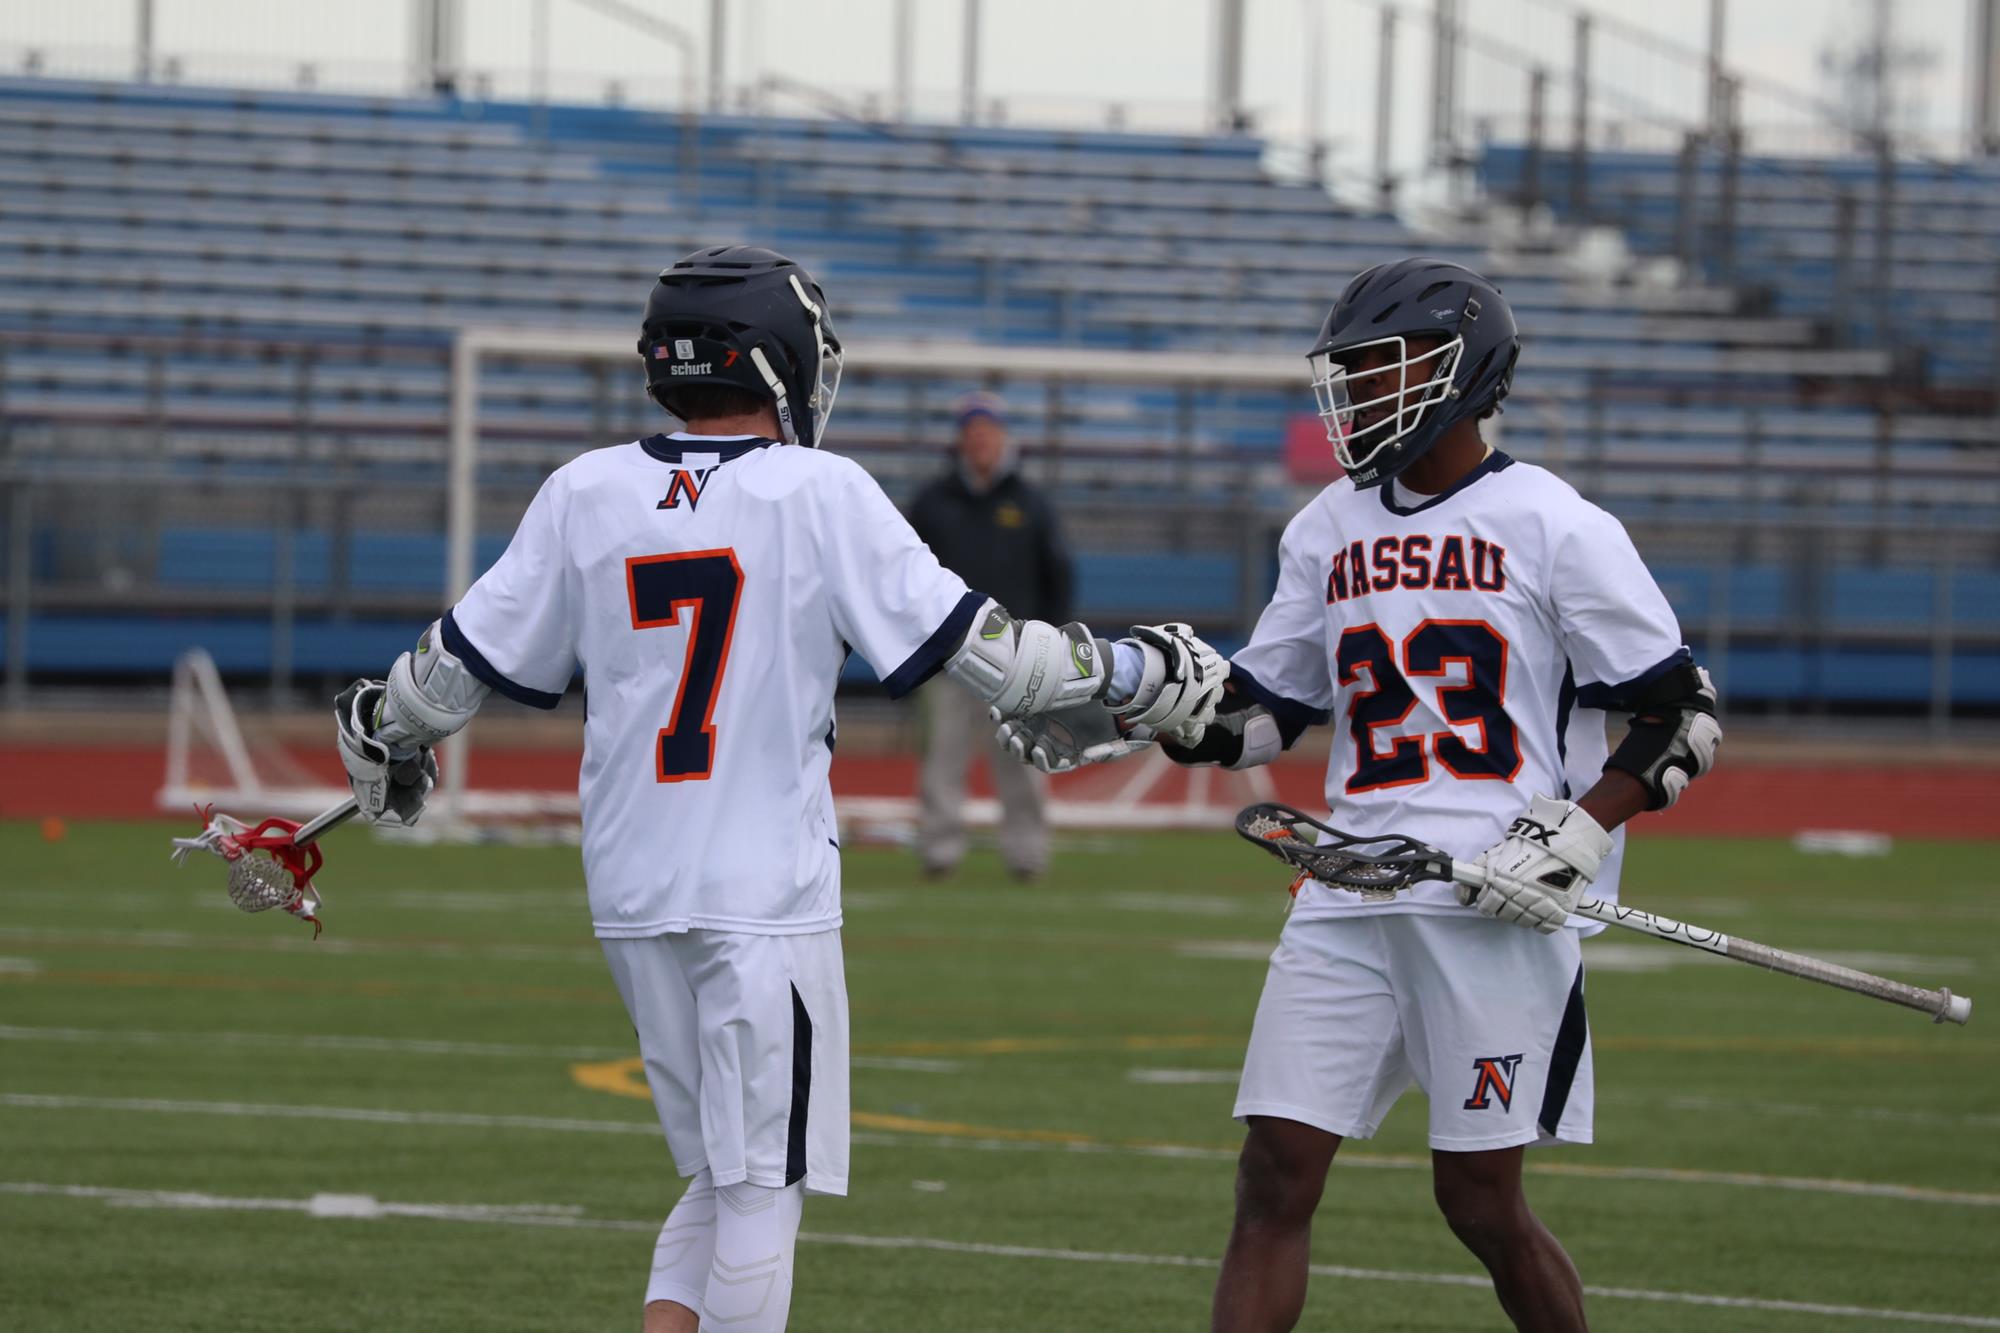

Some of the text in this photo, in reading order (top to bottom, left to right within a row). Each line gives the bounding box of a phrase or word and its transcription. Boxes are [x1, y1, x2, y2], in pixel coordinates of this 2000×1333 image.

[671, 361, 712, 375] schutt
[723, 350, 738, 368] 7
[780, 406, 790, 423] STX
[656, 465, 720, 513] N
[1326, 535, 1506, 605] NASSAU
[625, 547, 745, 783] 7
[1335, 618, 1524, 795] 23
[1505, 817, 1560, 848] STX
[1463, 1053, 1525, 1114] N
